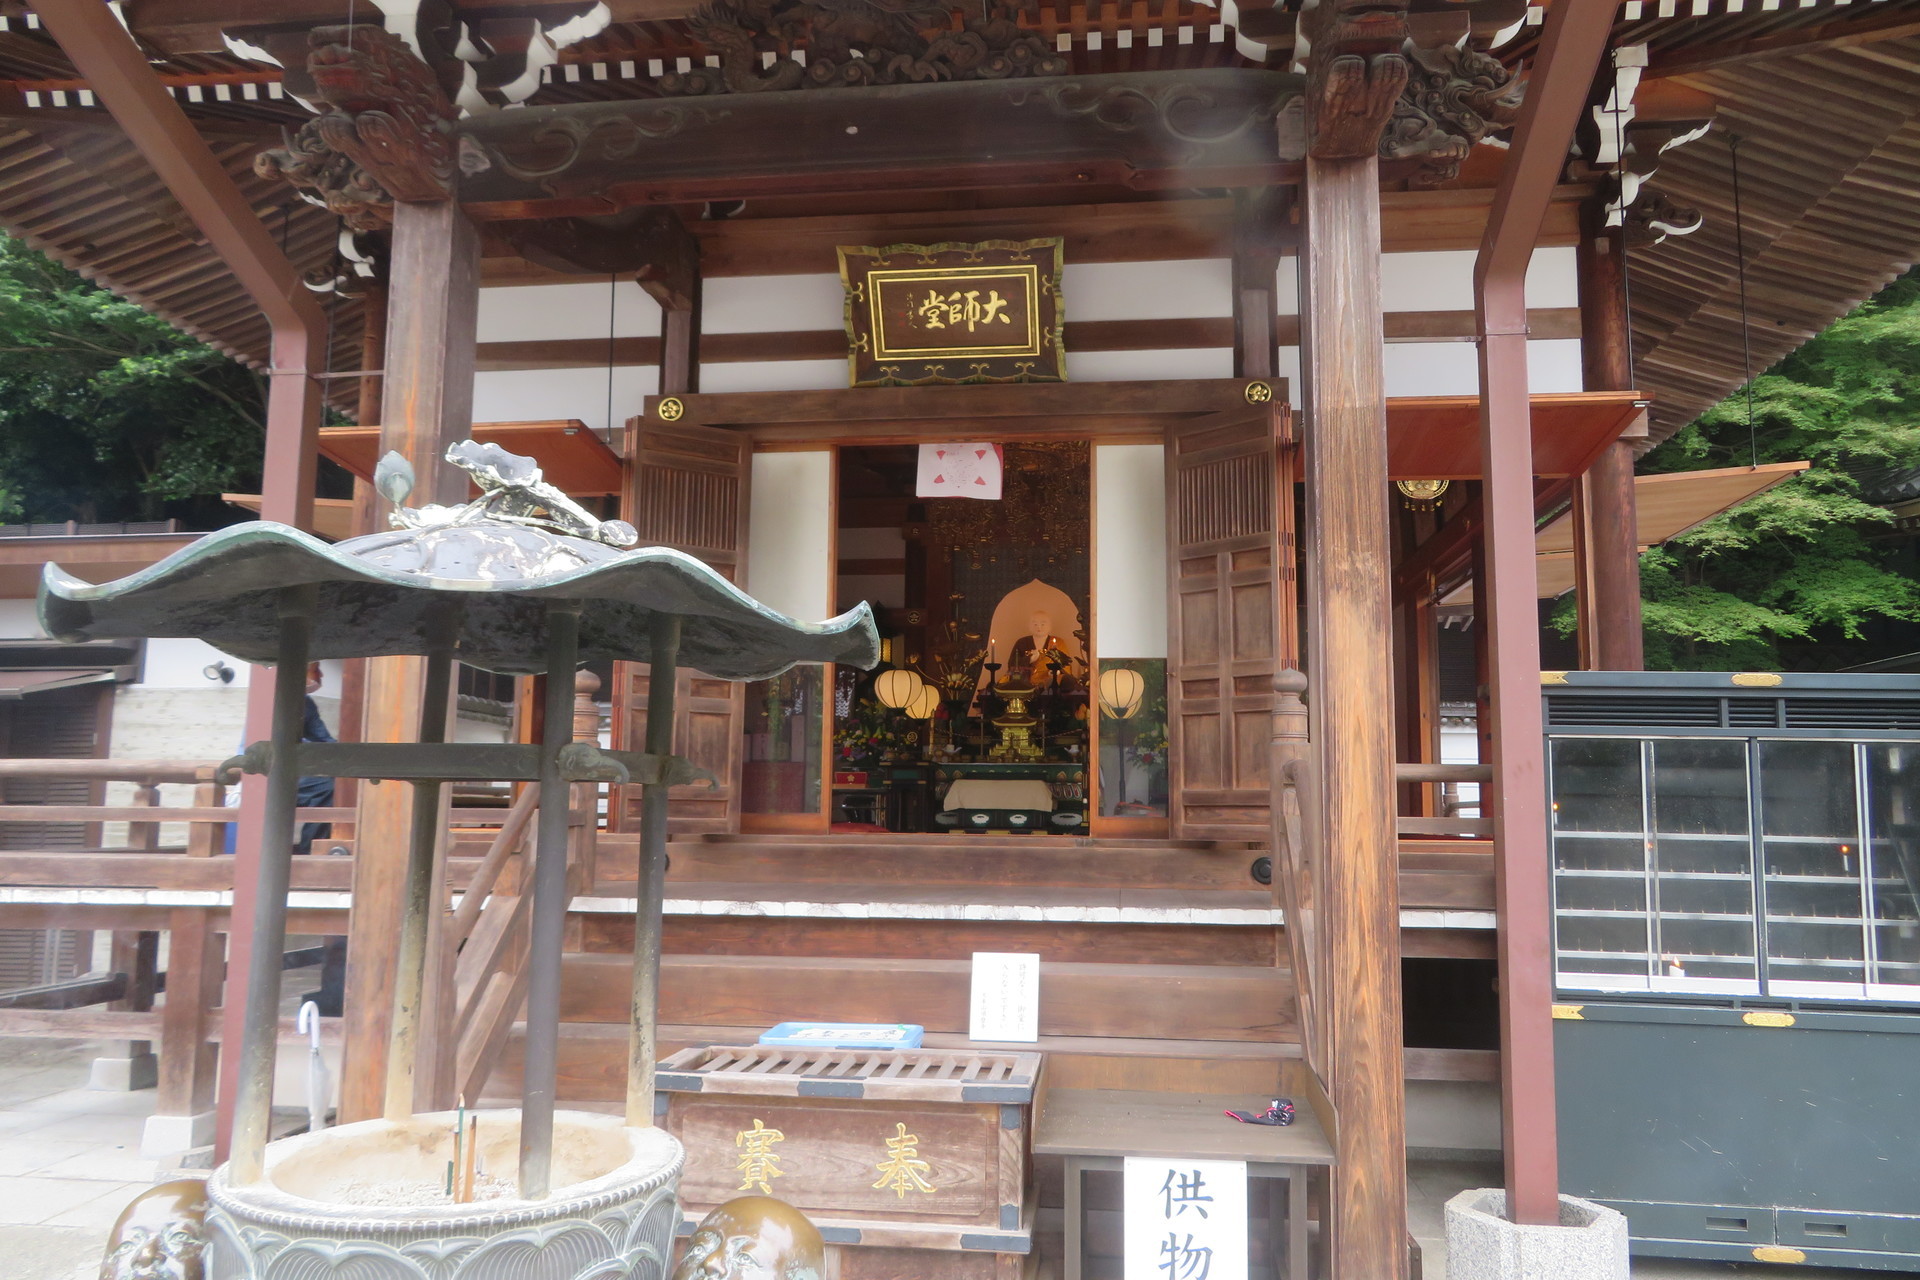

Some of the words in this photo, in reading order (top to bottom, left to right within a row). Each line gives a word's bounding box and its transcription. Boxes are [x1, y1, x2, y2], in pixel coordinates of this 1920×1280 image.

[918, 289, 1011, 333] 大師堂
[1157, 1168, 1214, 1280] 供物
